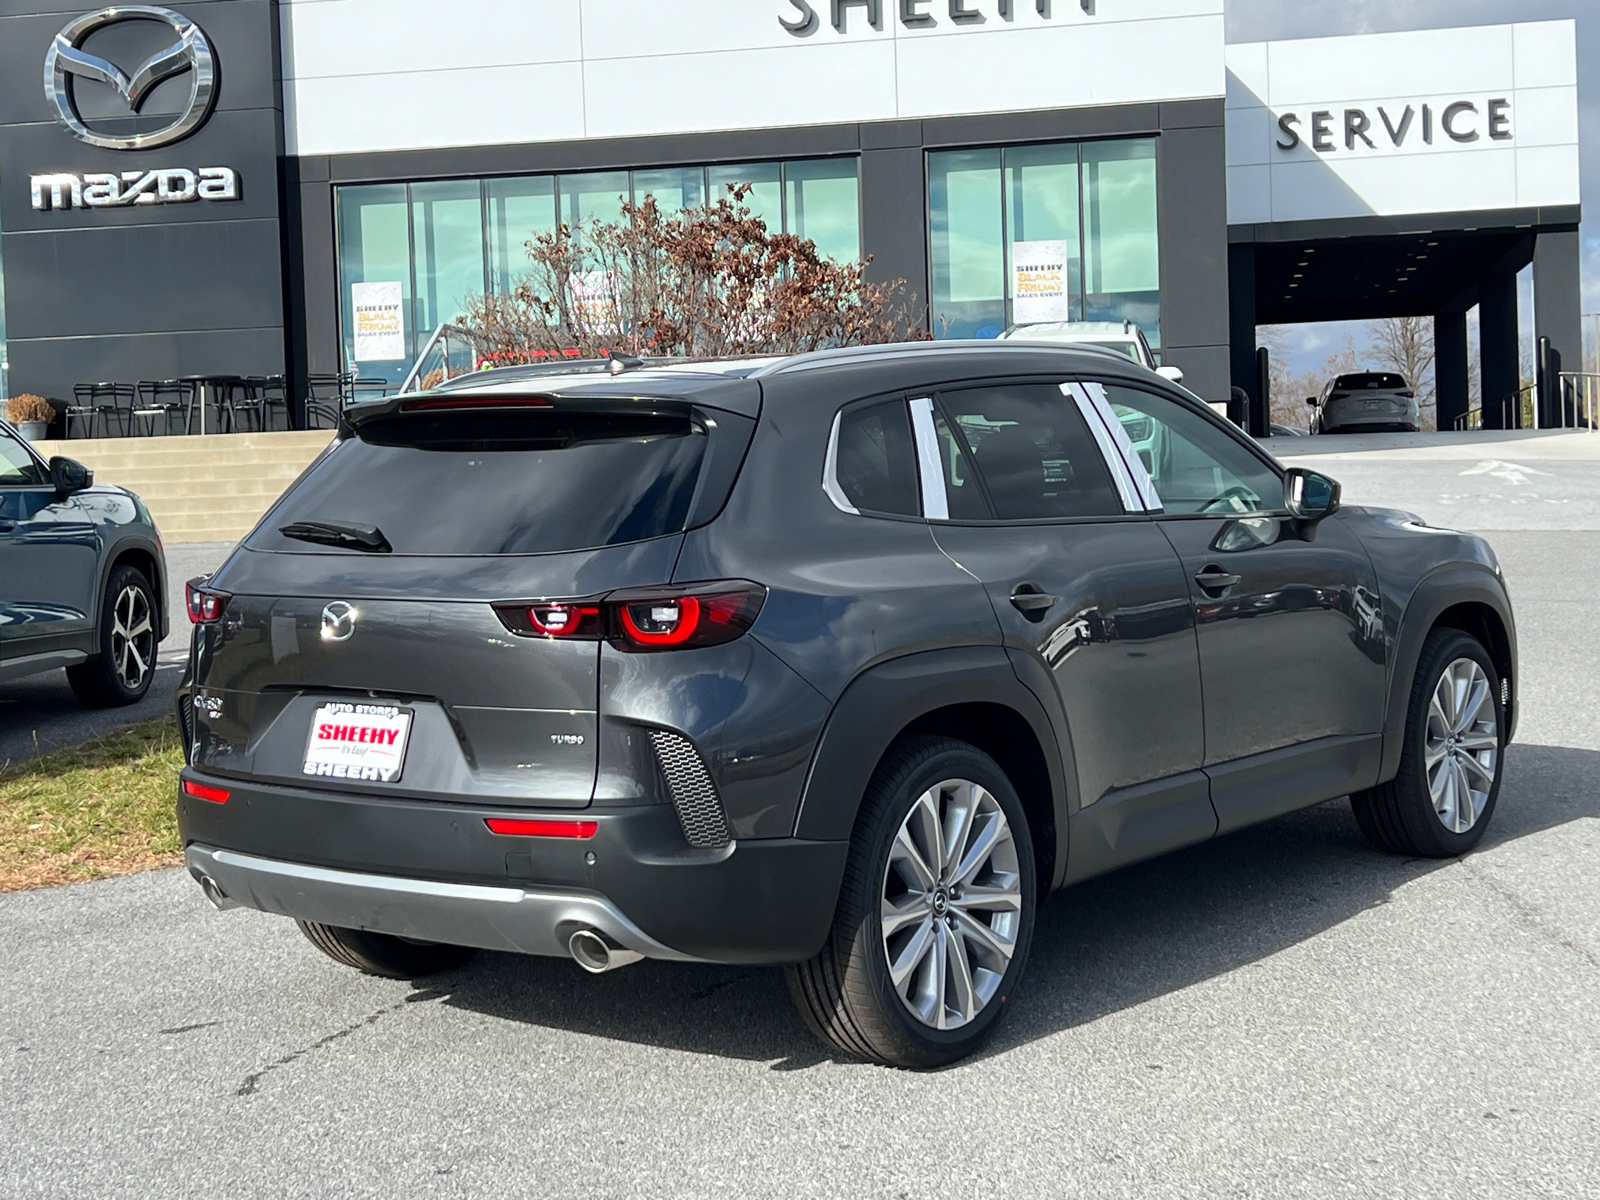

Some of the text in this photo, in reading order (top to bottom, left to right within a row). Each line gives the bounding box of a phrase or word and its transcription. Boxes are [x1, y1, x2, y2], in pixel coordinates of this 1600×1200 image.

[1276, 98, 1512, 152] SERVICE
[1016, 264, 1063, 272] SHEEHY
[1018, 271, 1061, 282] BLACK
[1017, 281, 1063, 293] FRIDAY
[358, 311, 398, 322] BLACK
[358, 320, 400, 332] FRIDAY
[325, 703, 399, 716] AUTO STORES
[318, 724, 400, 746] SHEEHY
[550, 734, 584, 744] TURBO
[341, 745, 369, 758] It's Easy!
[303, 761, 397, 782] SHEEHY
